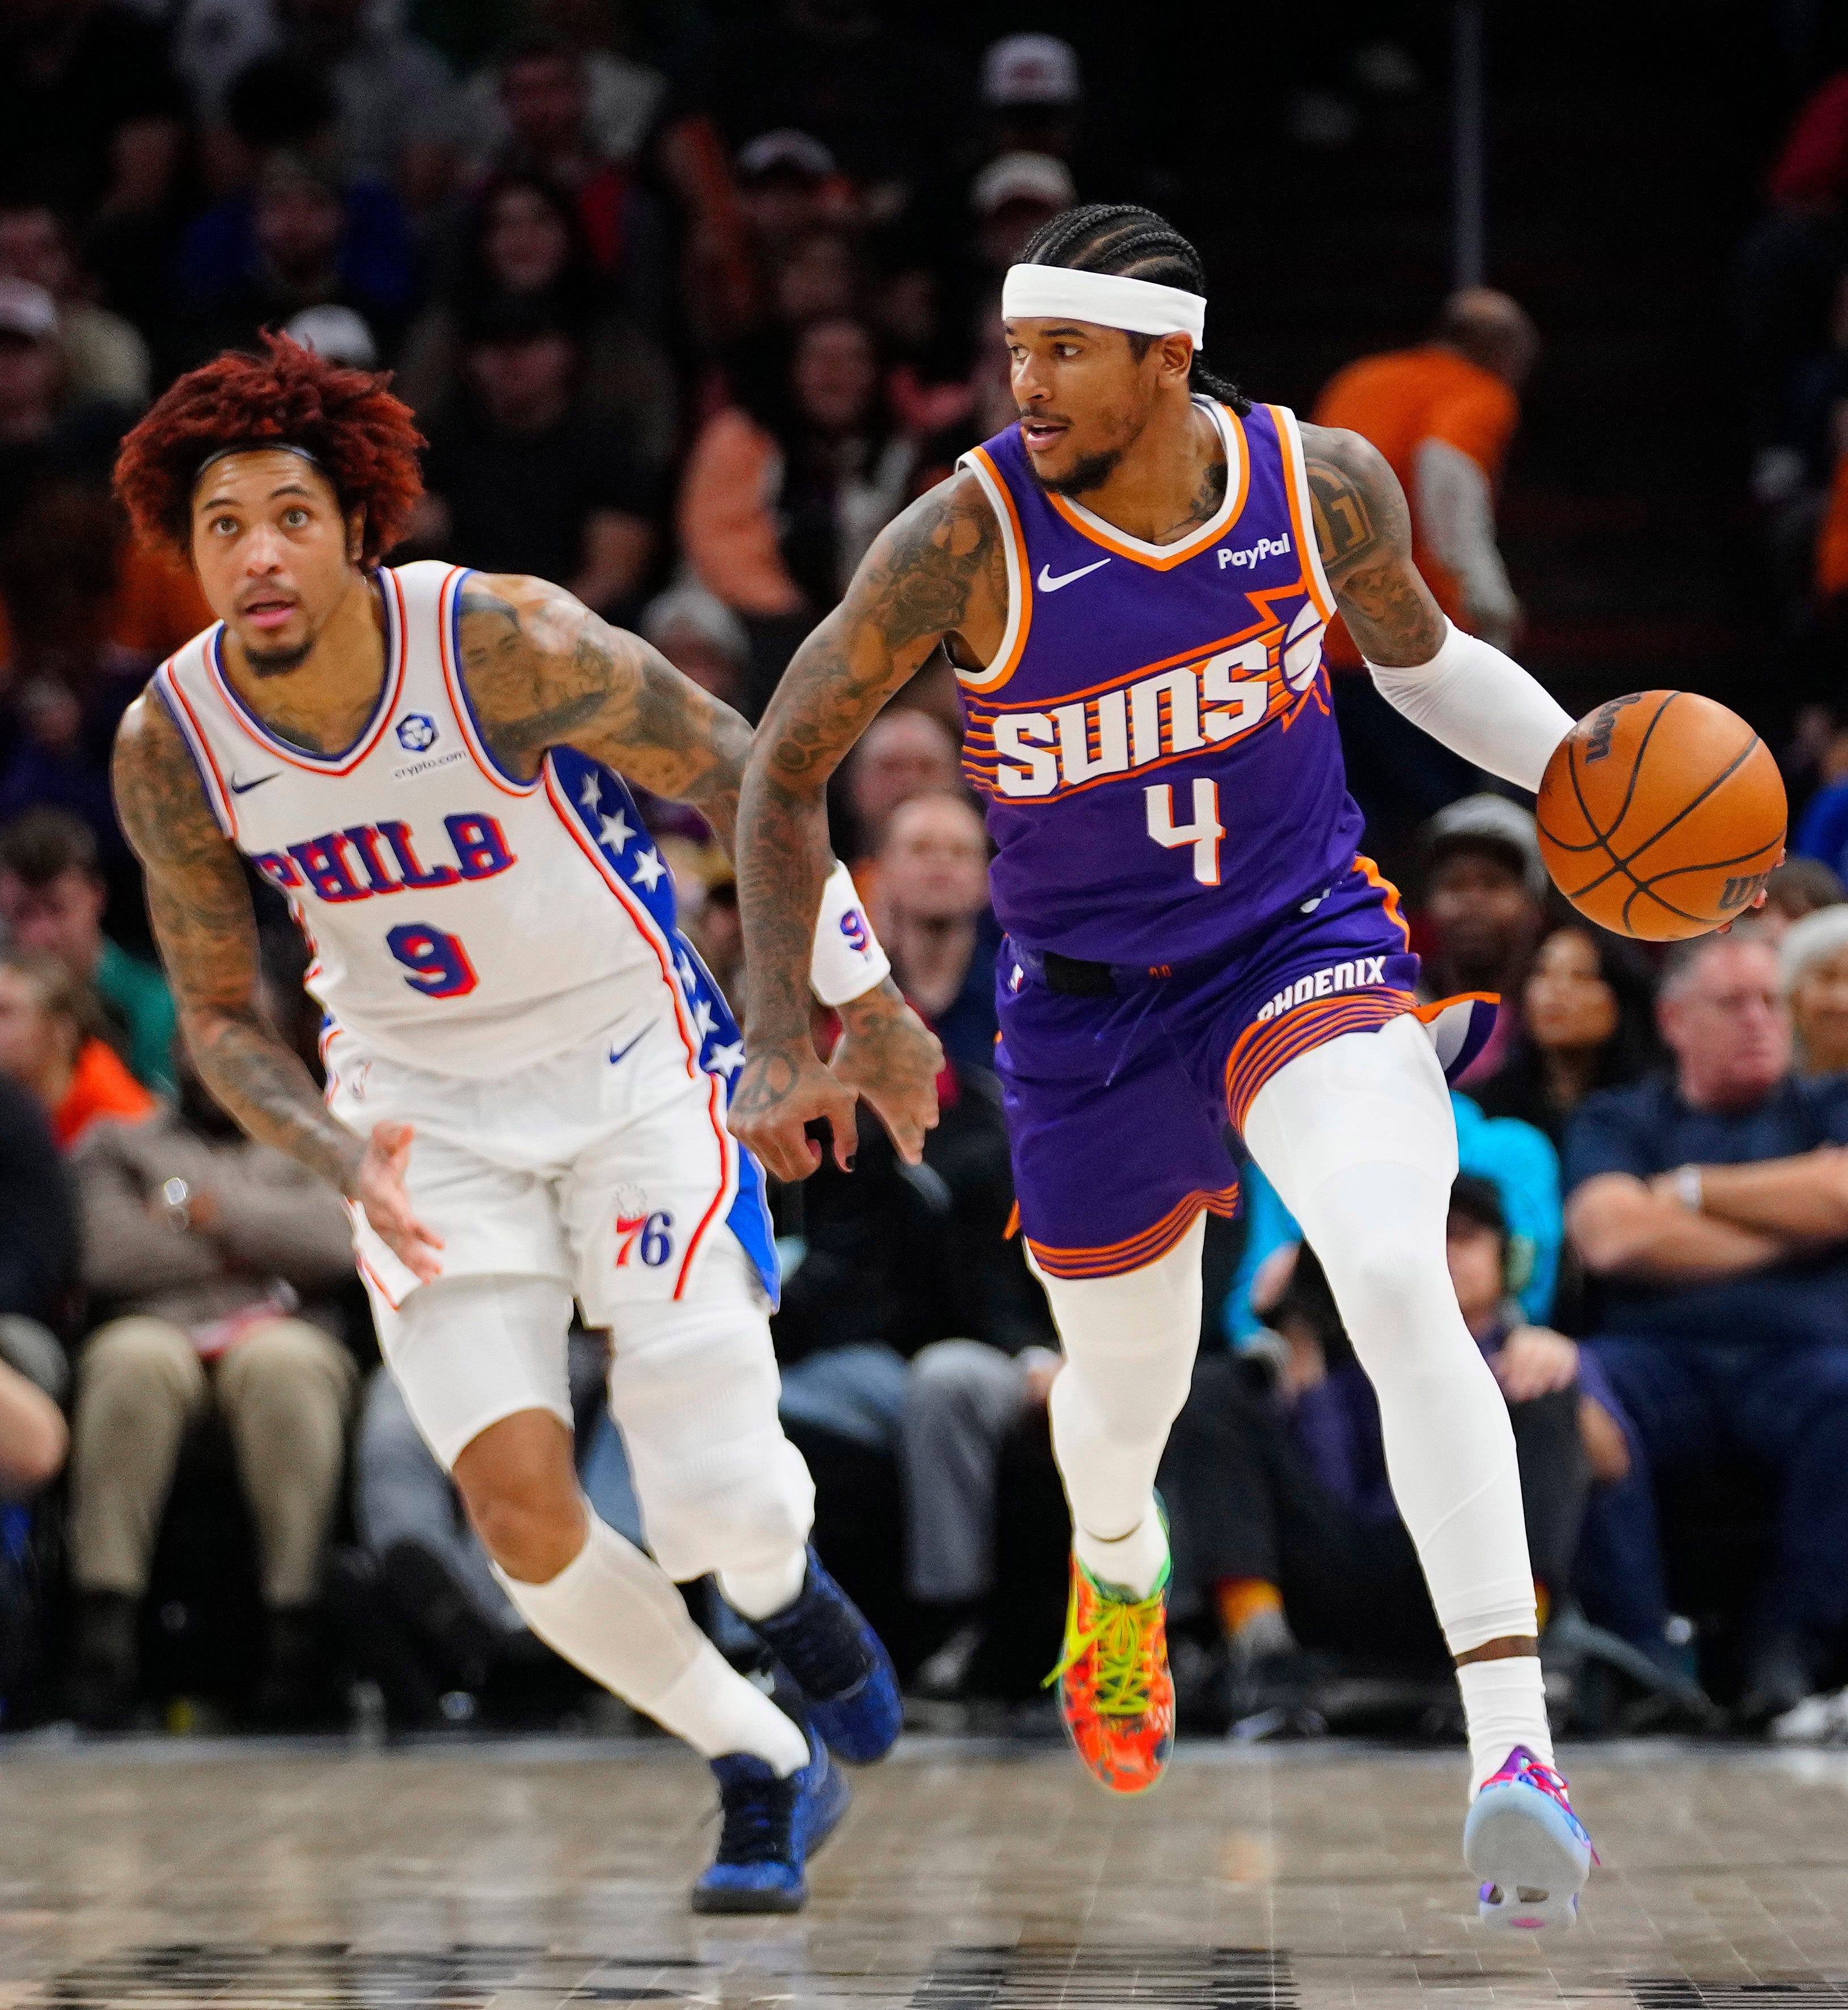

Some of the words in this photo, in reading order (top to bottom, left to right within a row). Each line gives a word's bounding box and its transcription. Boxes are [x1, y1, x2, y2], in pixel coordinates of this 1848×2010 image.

[1217, 532, 1291, 570] PayPal
[992, 639, 1269, 797] SUNS
[394, 750, 467, 778] crypto.com
[249, 811, 518, 903] PHILA
[1143, 777, 1227, 886] 4
[386, 921, 480, 999] 9
[840, 908, 870, 953] 9
[1256, 955, 1387, 1021] PHOENIX
[615, 1209, 674, 1268] 76
